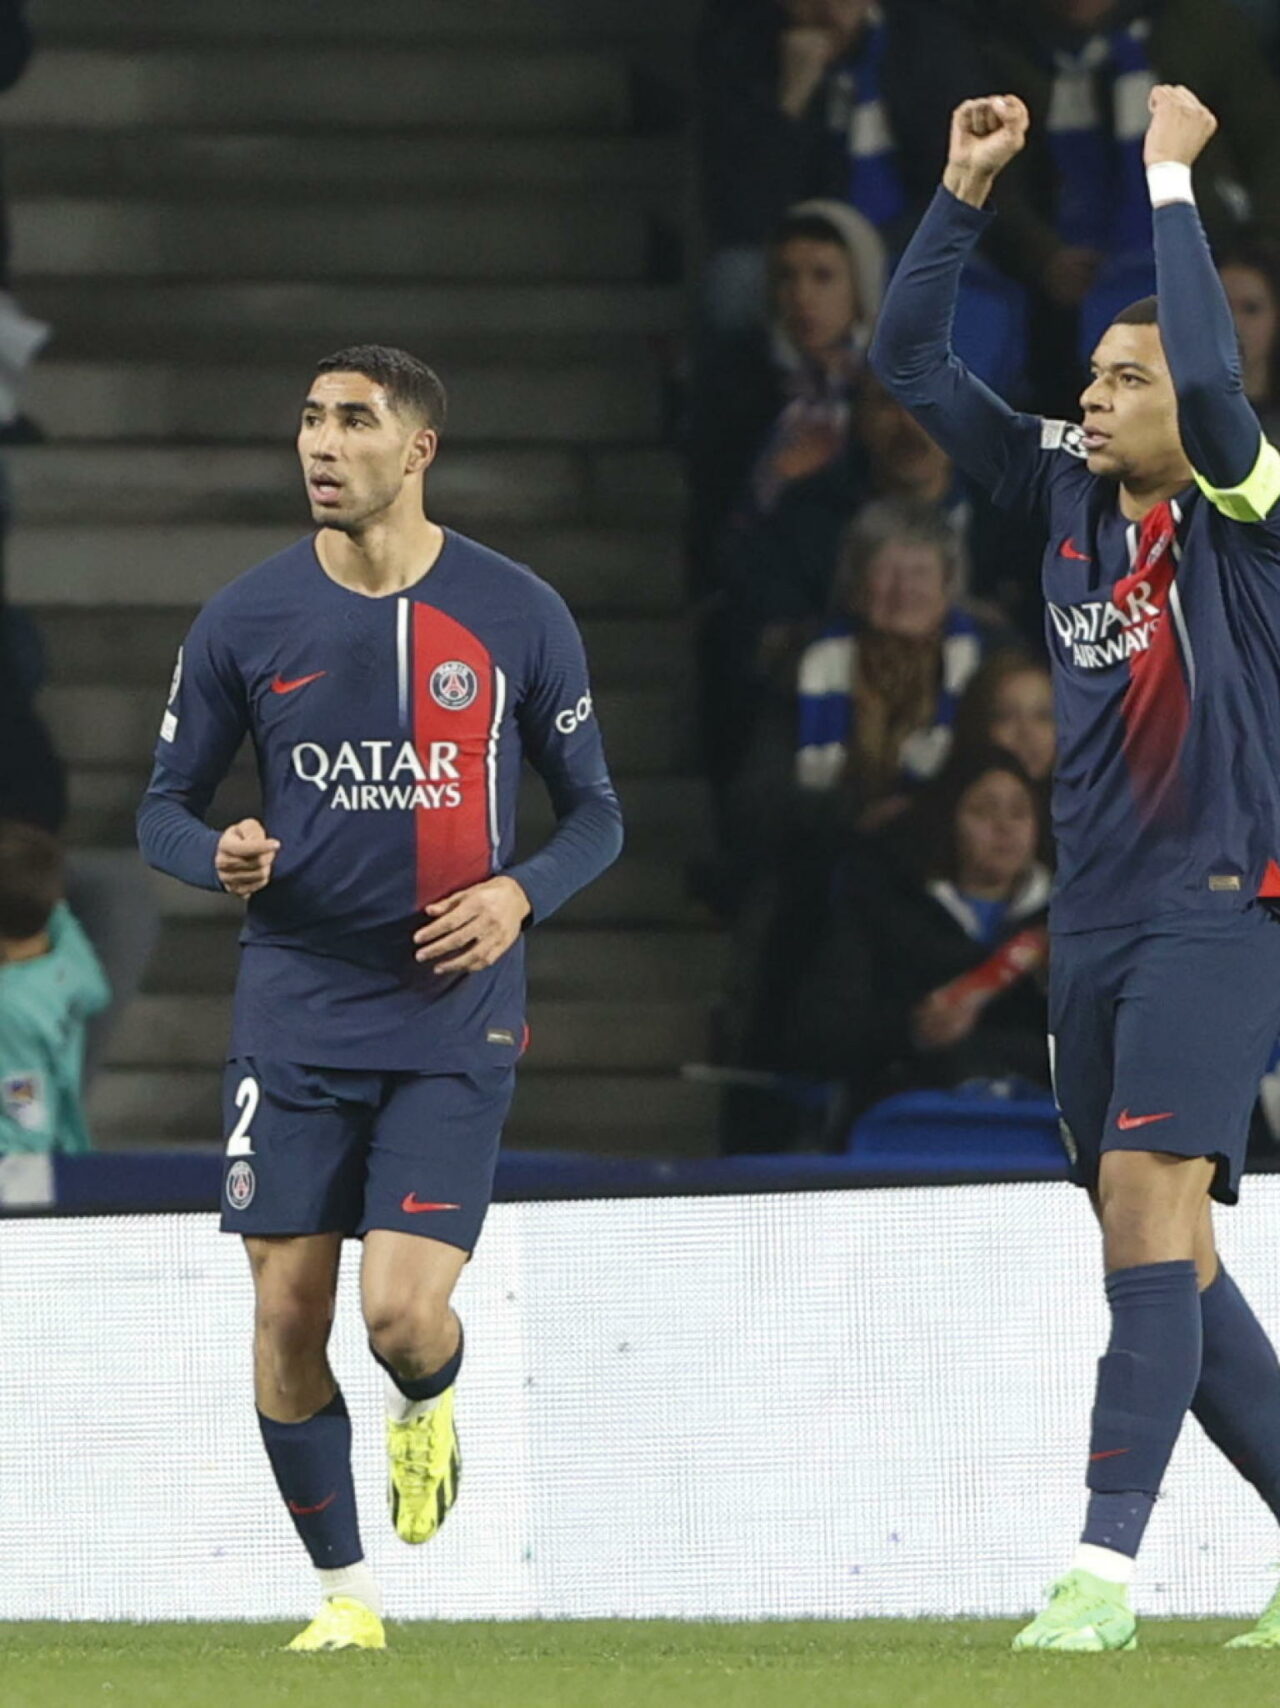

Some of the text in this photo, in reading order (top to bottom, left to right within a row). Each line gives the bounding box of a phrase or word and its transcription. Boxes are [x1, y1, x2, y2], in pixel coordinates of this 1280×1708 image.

[1047, 581, 1159, 647] QATAR
[555, 688, 592, 734] GO
[291, 740, 460, 791] QATAR
[330, 782, 462, 811] AIRWAYS
[226, 1076, 260, 1157] 2
